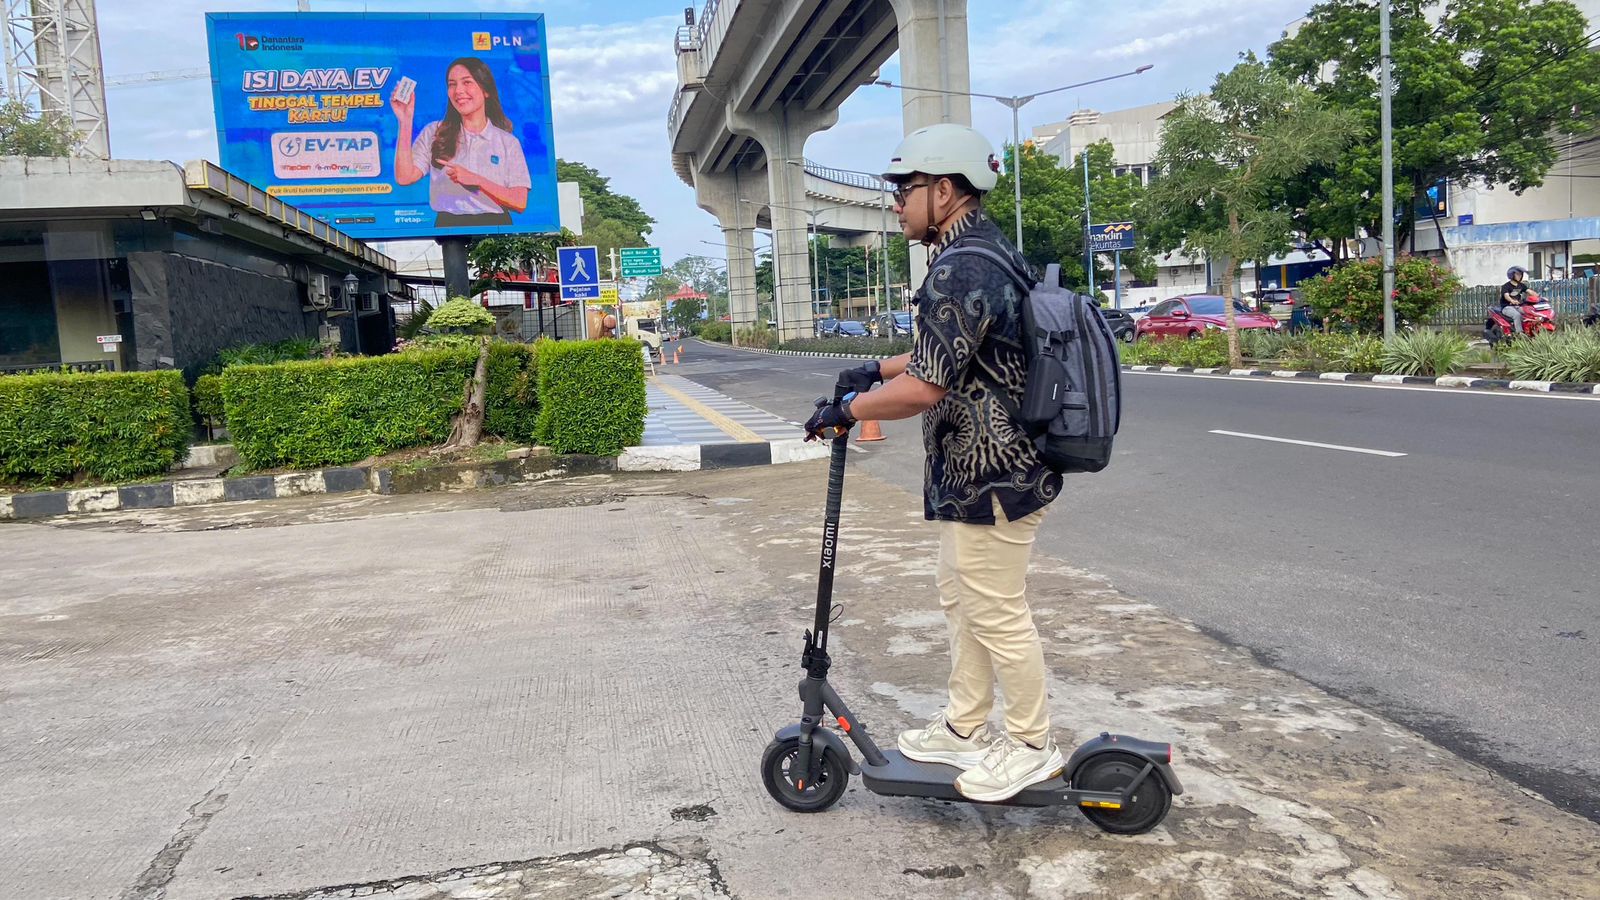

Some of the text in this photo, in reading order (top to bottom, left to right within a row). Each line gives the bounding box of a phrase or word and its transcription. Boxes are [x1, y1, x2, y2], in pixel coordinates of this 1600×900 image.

[492, 36, 522, 46] PLN
[243, 67, 391, 91] ISI DAYA EV
[248, 93, 383, 110] TINGGAL TEMPEL
[288, 109, 348, 123] KARTU!
[304, 137, 373, 152] EV-TAP
[822, 522, 836, 569] xiaomi
